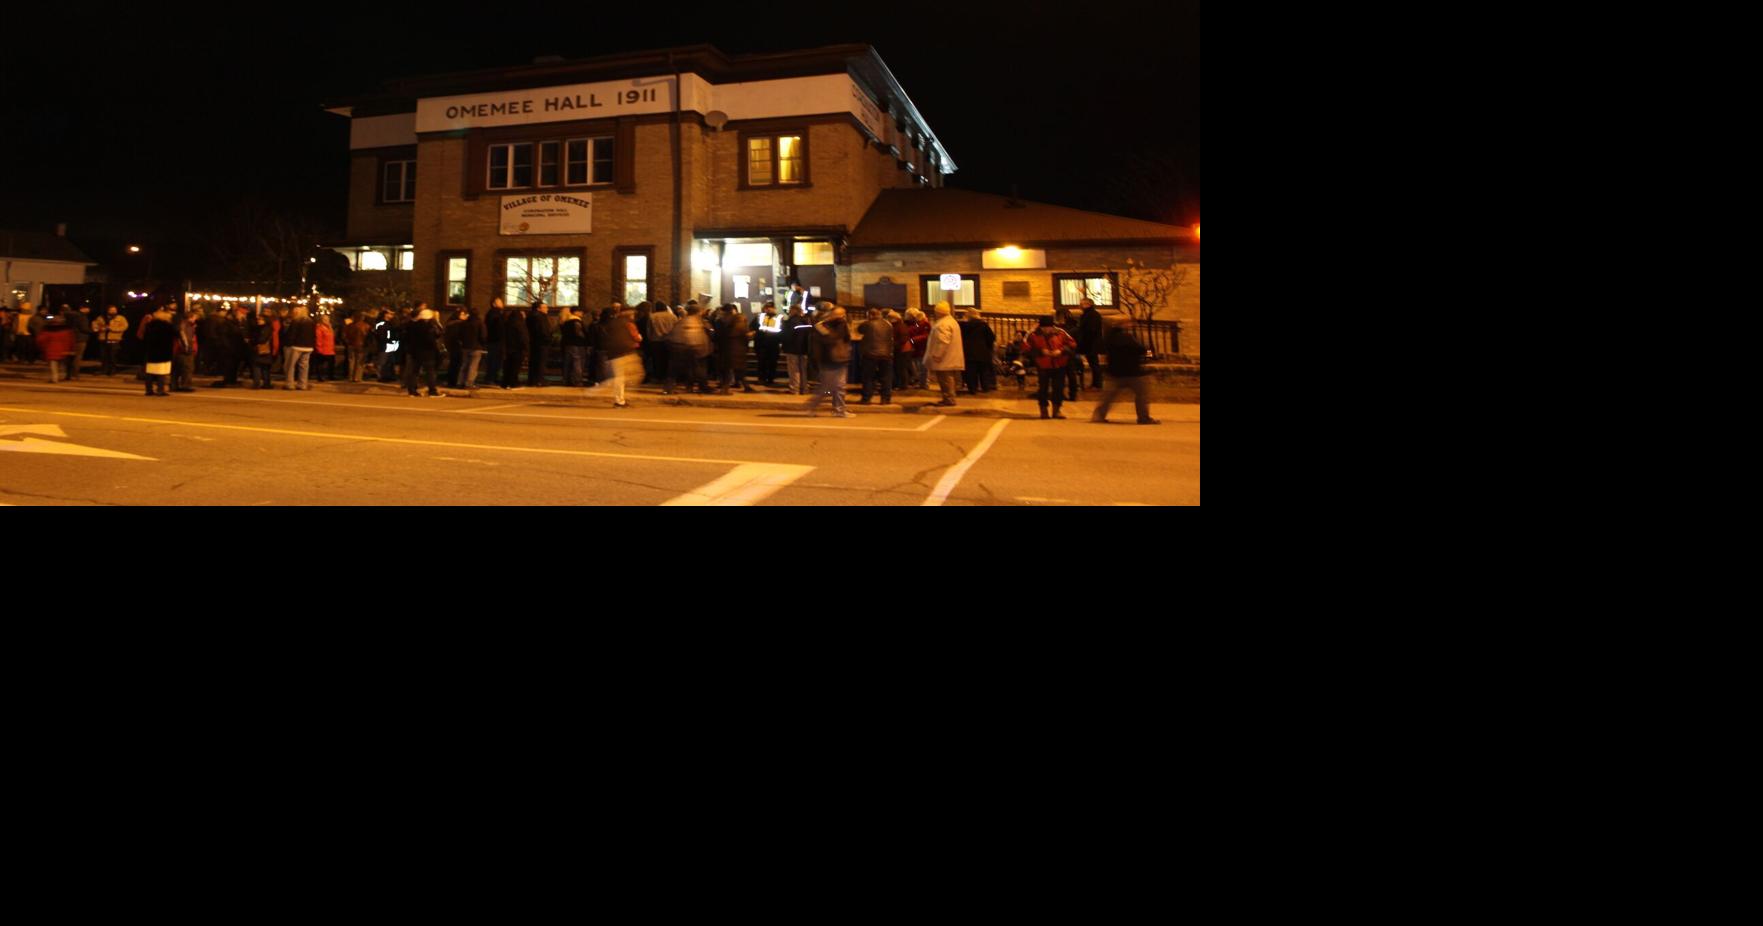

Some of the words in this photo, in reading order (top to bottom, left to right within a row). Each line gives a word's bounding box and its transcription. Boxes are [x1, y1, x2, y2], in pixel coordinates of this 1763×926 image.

[446, 100, 533, 119] OMEMEE
[544, 93, 603, 112] HALL
[617, 88, 656, 105] 1911
[503, 195, 537, 210] VILLAGE
[540, 194, 552, 202] OF
[554, 195, 590, 208] OMEMEE
